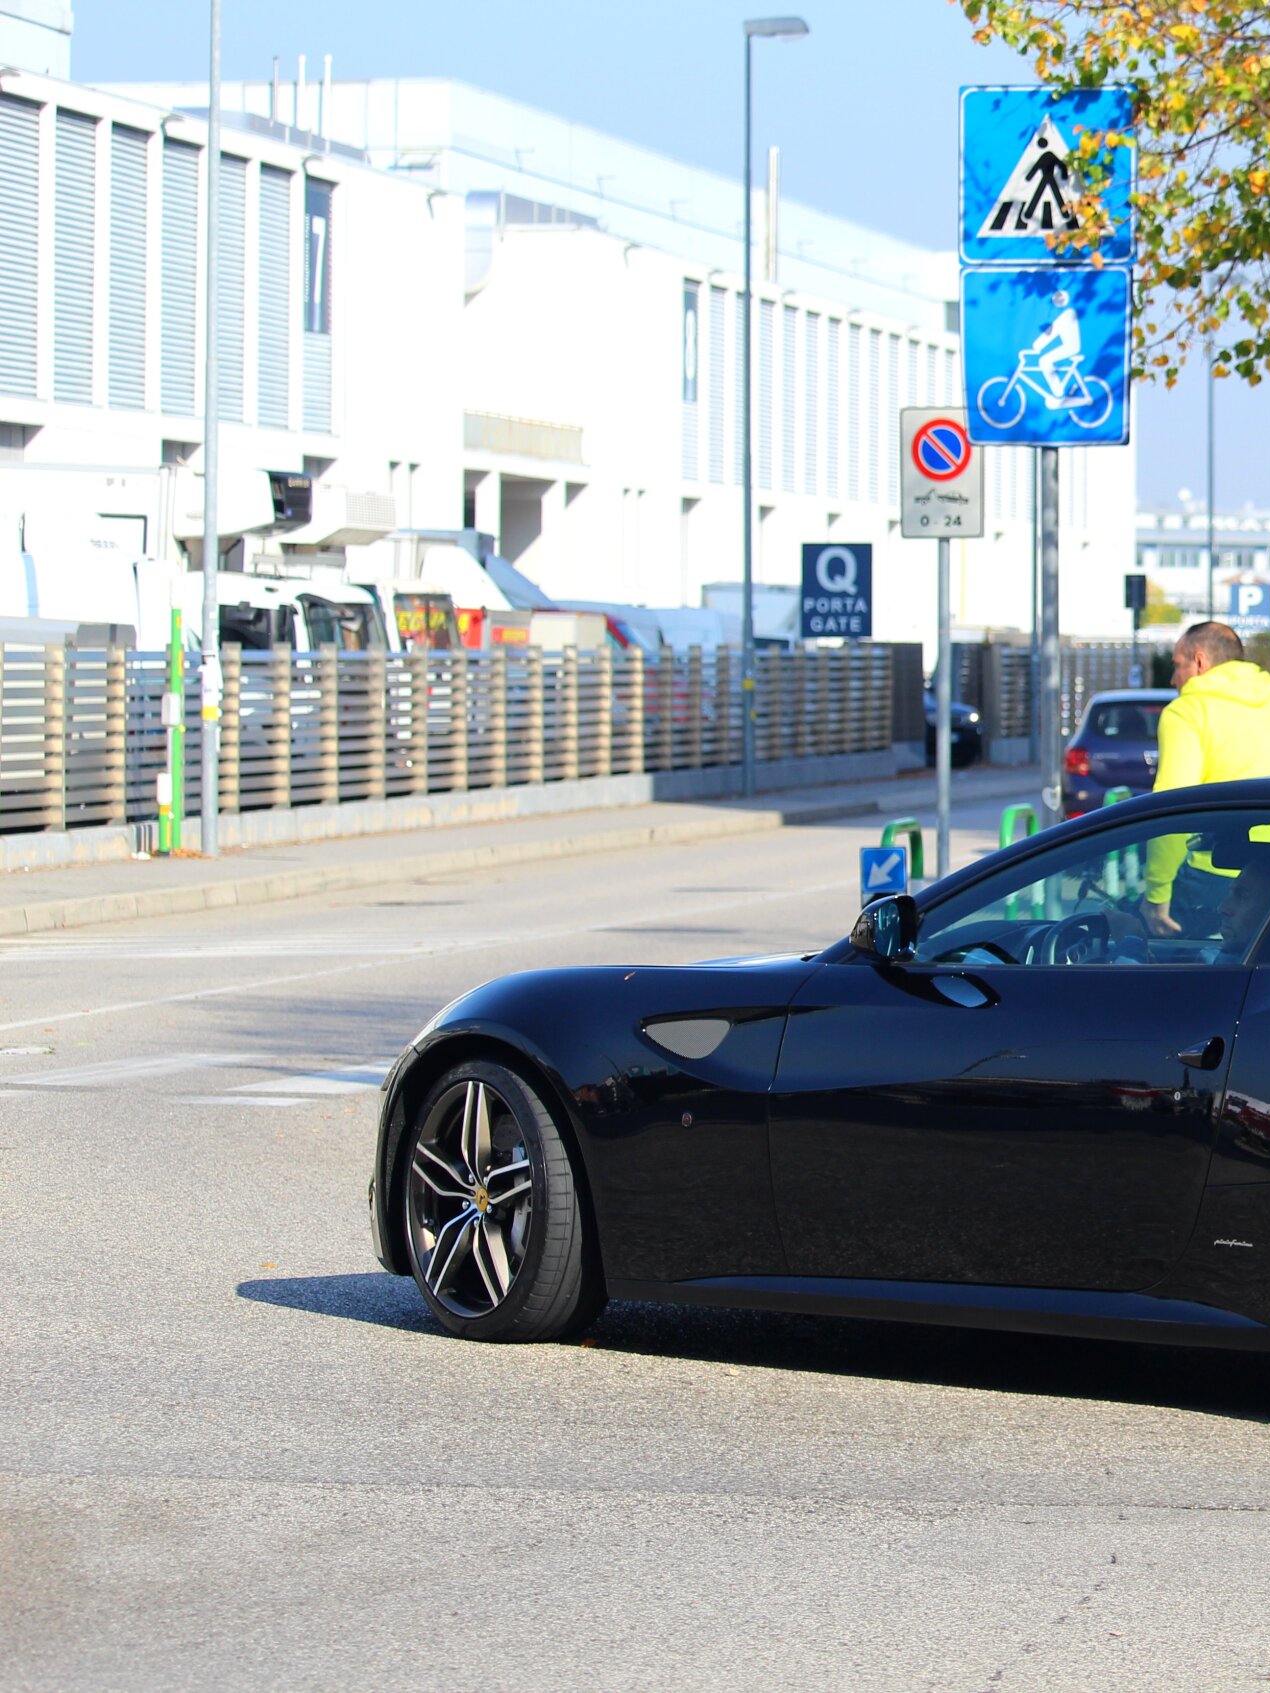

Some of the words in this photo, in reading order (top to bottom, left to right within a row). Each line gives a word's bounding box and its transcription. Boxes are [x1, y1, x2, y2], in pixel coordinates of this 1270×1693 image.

[944, 514, 962, 527] 24
[816, 546, 858, 595] Q
[803, 597, 868, 613] PORTA
[1238, 585, 1264, 615] P
[810, 616, 862, 632] GATE
